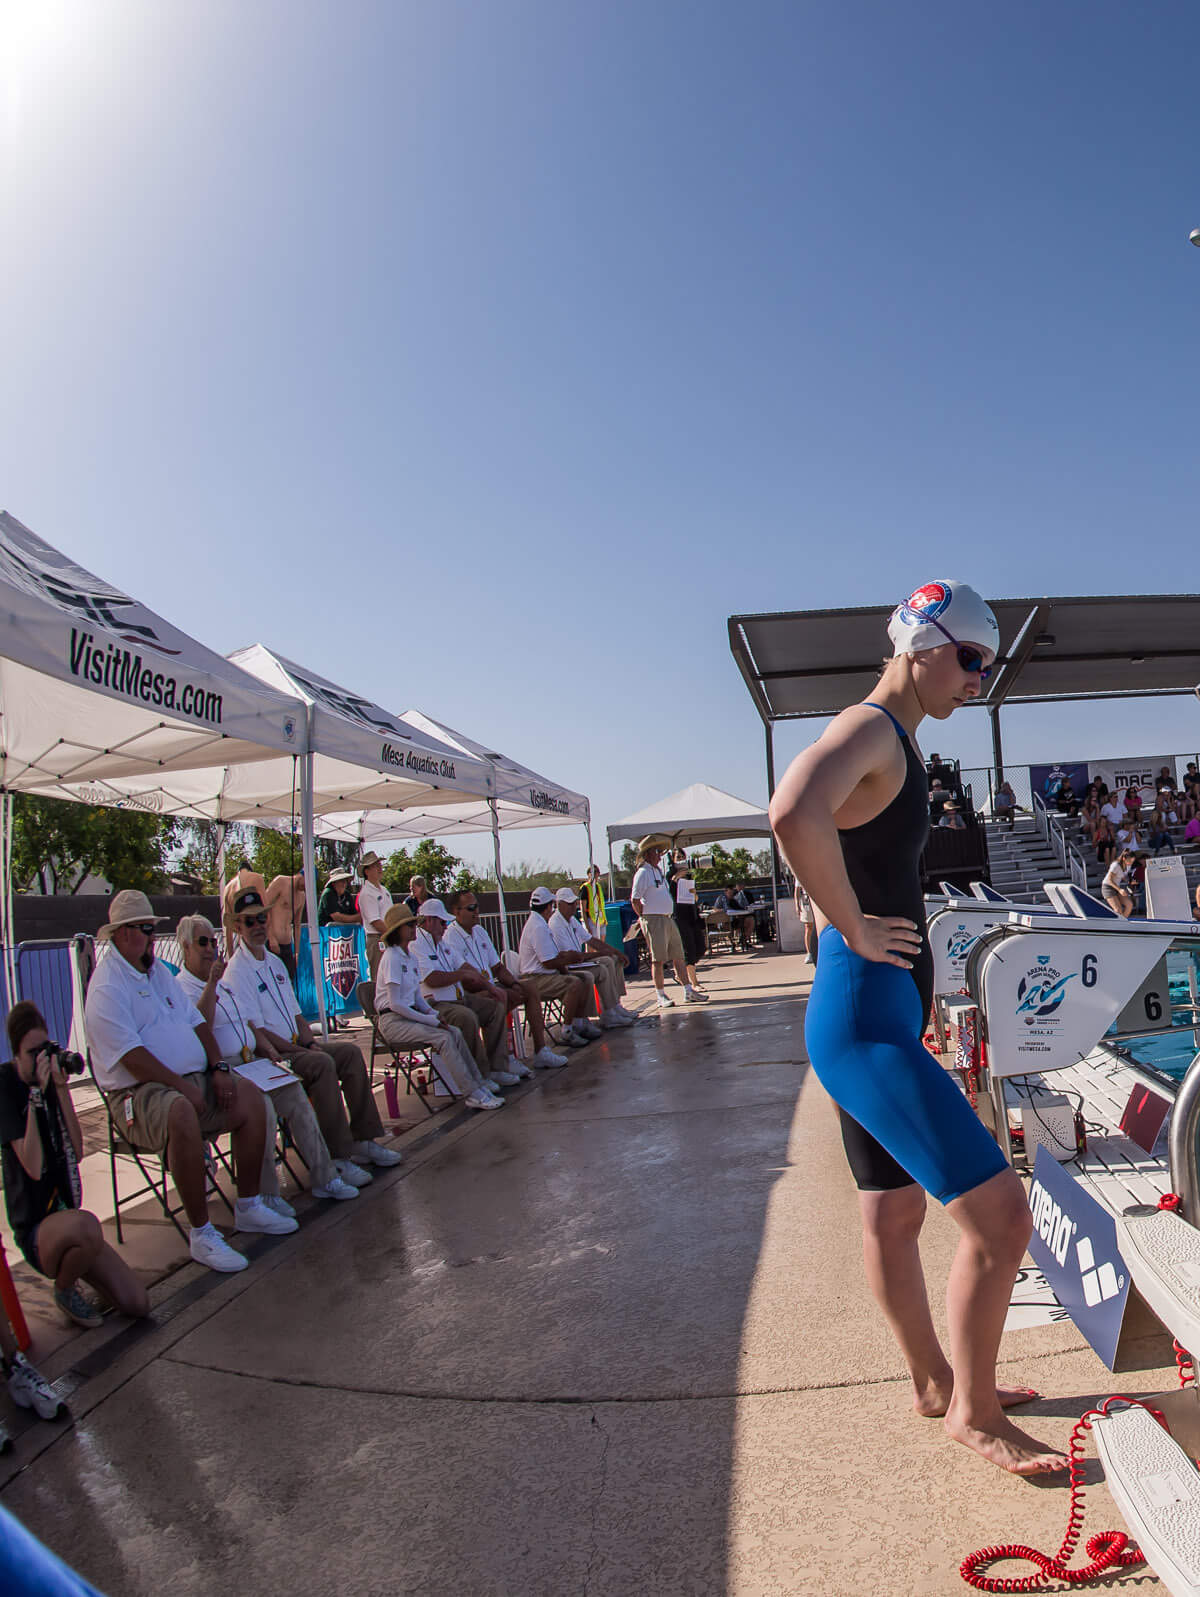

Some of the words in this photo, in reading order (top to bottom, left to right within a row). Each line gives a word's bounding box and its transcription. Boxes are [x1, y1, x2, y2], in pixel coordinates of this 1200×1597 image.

[70, 627, 223, 724] VisitMesa.com
[381, 743, 405, 767] Mesa
[405, 750, 439, 775] Aquatics
[332, 943, 352, 961] USA
[1081, 953, 1098, 988] 6
[1143, 991, 1163, 1022] 6
[1029, 1179, 1073, 1268] arena
